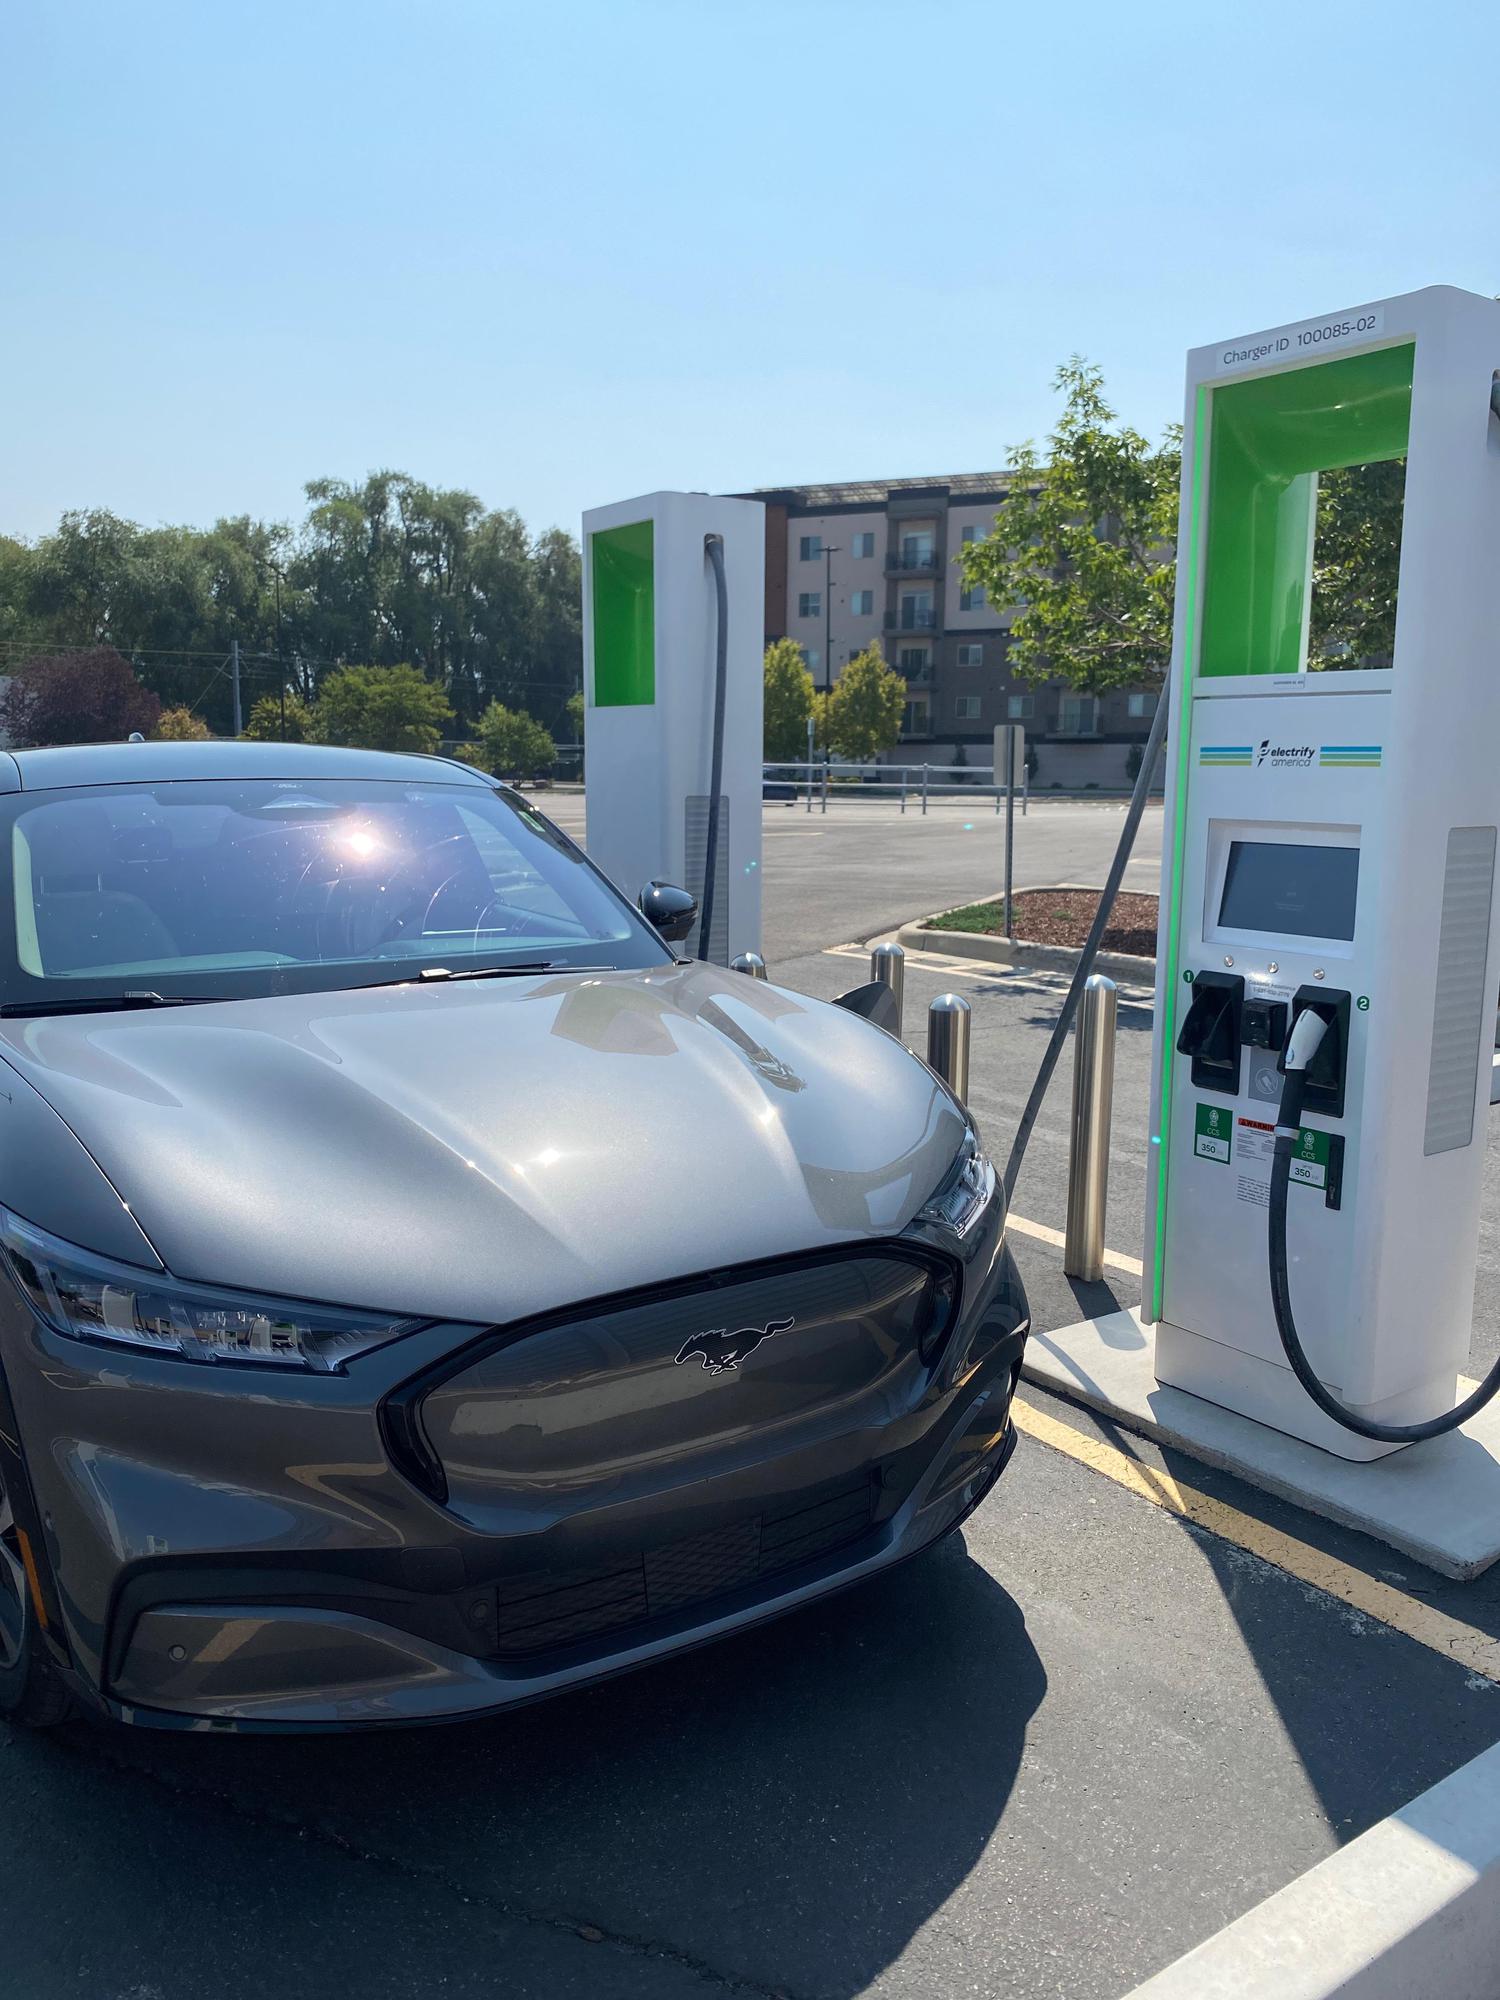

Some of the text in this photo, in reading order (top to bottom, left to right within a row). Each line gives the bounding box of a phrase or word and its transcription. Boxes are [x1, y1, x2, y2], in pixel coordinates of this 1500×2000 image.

[1223, 316, 1376, 365] Charger ID 100085-02
[1271, 746, 1315, 758] electrify
[1271, 758, 1311, 767] america
[1207, 1128, 1220, 1136] CCS
[1201, 1143, 1216, 1153] 350
[1301, 1151, 1316, 1160] CCS
[1295, 1168, 1311, 1178] 350
